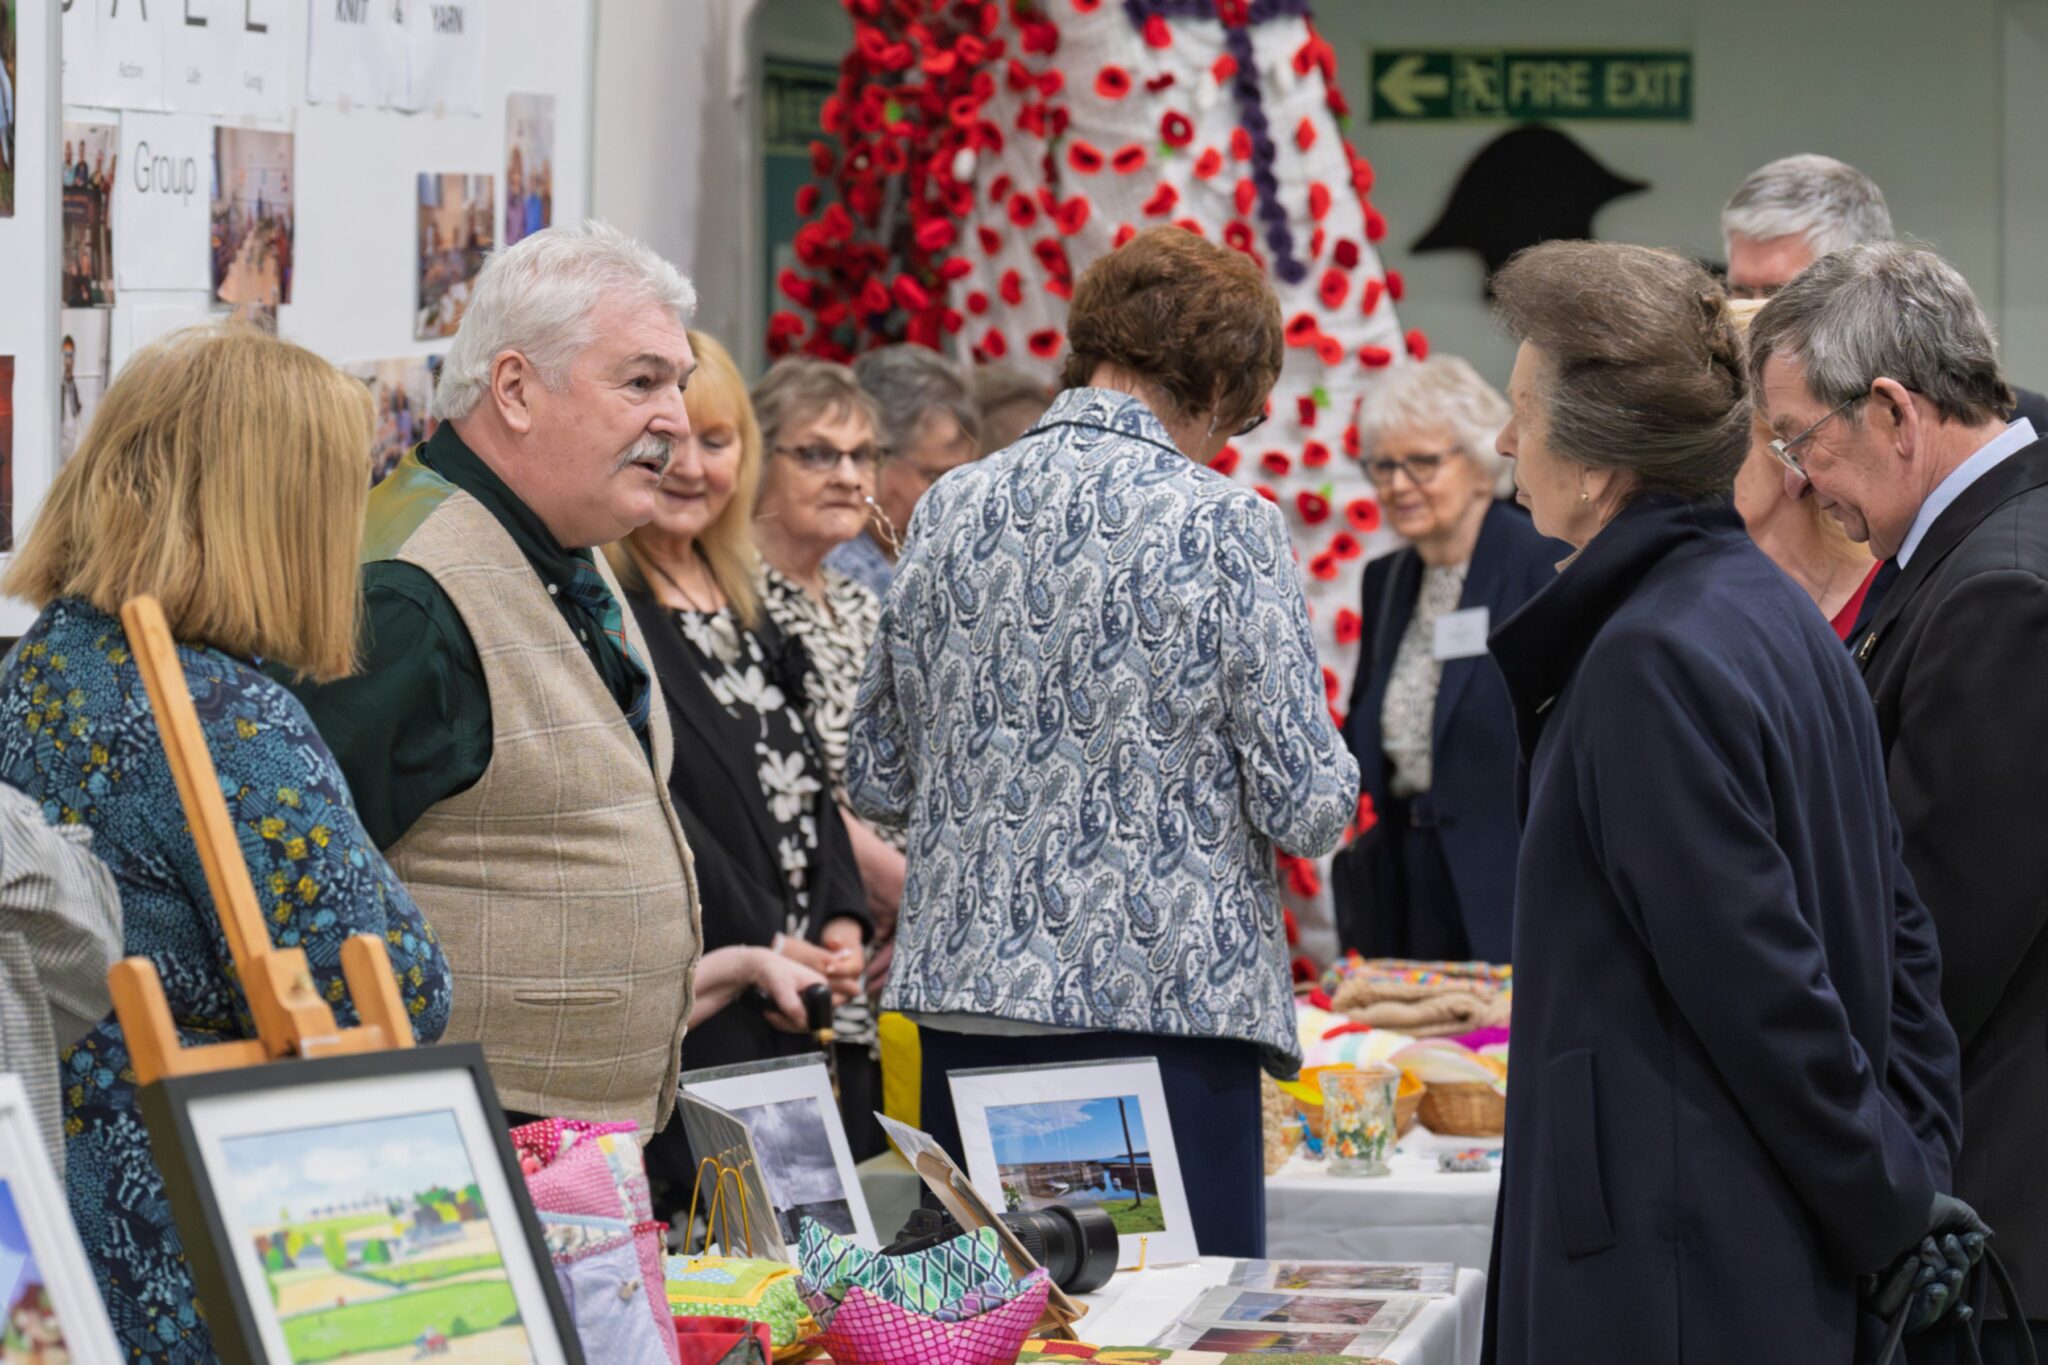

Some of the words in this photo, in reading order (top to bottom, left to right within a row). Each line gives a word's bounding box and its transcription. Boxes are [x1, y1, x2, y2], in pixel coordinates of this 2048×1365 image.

[335, 0, 368, 24] KNIT
[430, 4, 464, 34] YARN
[1508, 61, 1591, 106] FIRE
[1604, 61, 1685, 106] EXIT
[134, 140, 196, 207] Group
